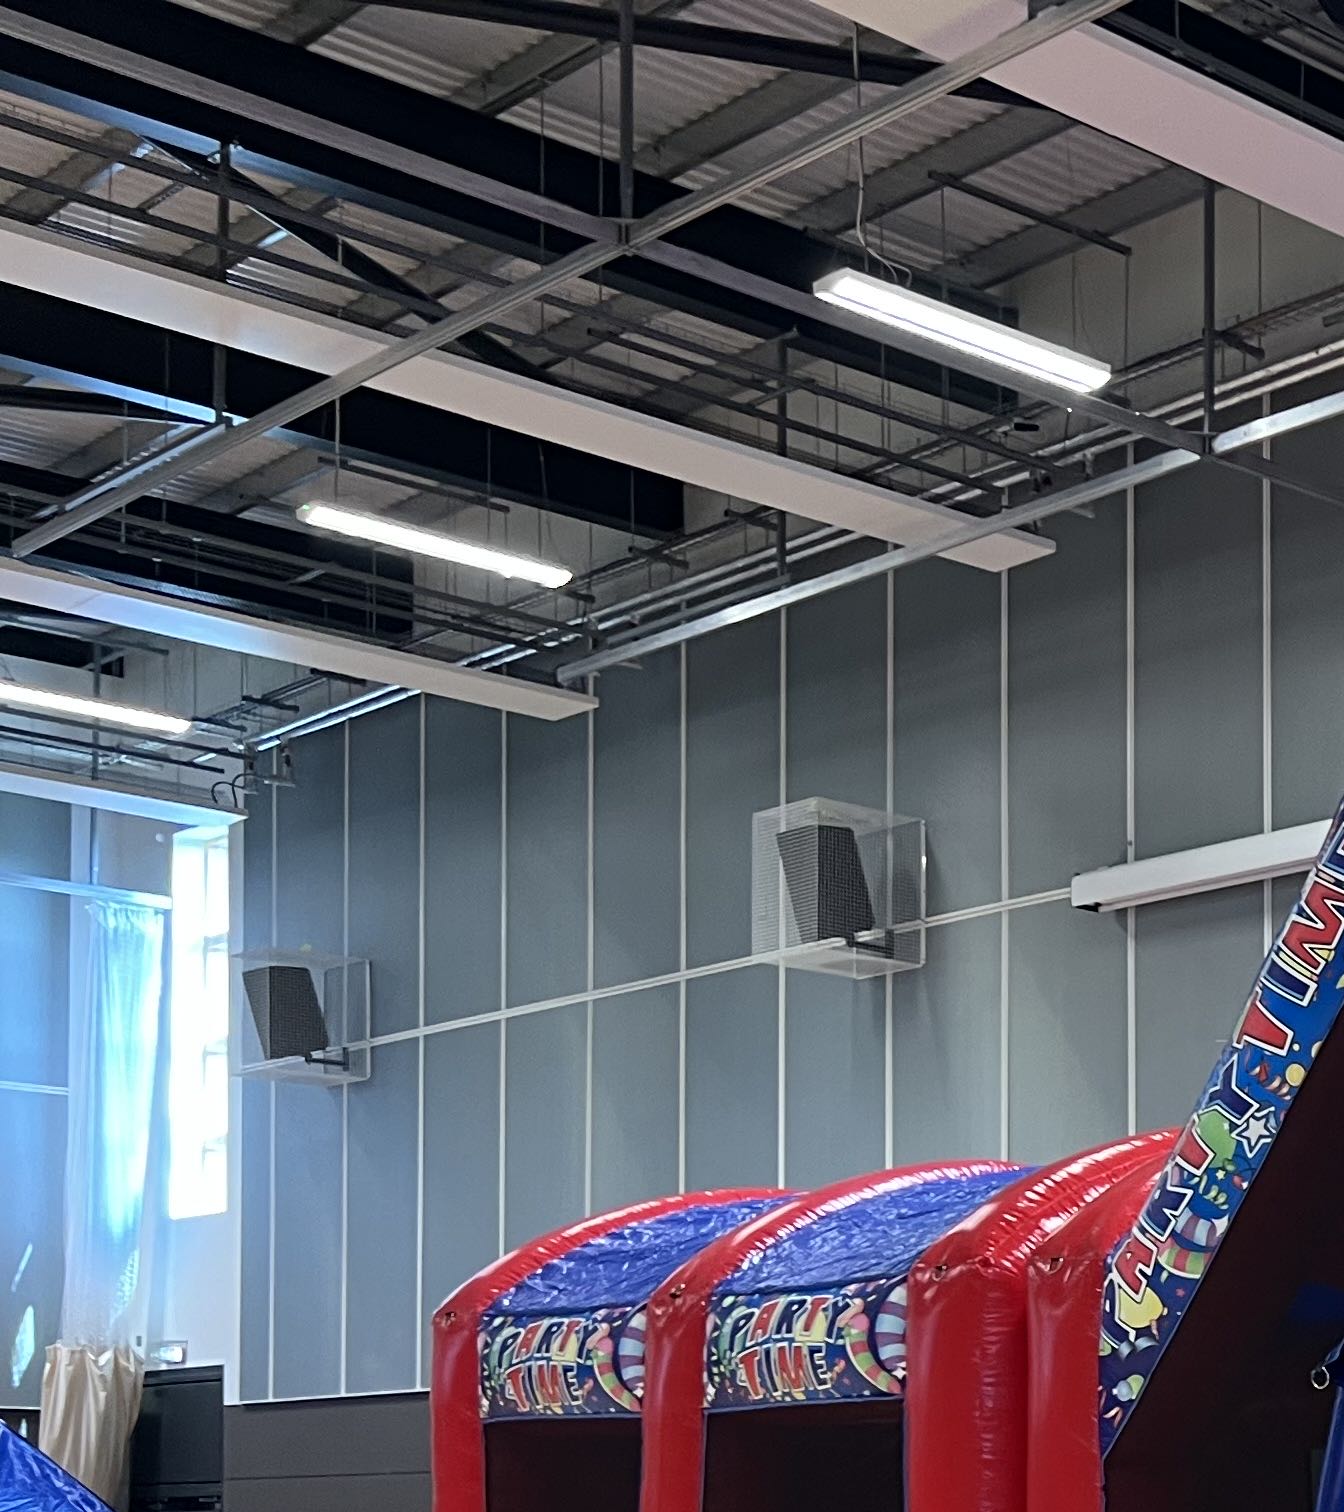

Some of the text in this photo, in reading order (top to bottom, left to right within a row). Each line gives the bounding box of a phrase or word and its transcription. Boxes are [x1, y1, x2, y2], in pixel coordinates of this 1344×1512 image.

[496, 1317, 601, 1373] PARTY
[729, 1295, 854, 1357] PARTY
[504, 1359, 584, 1412] TIME
[737, 1342, 833, 1400] TIME
